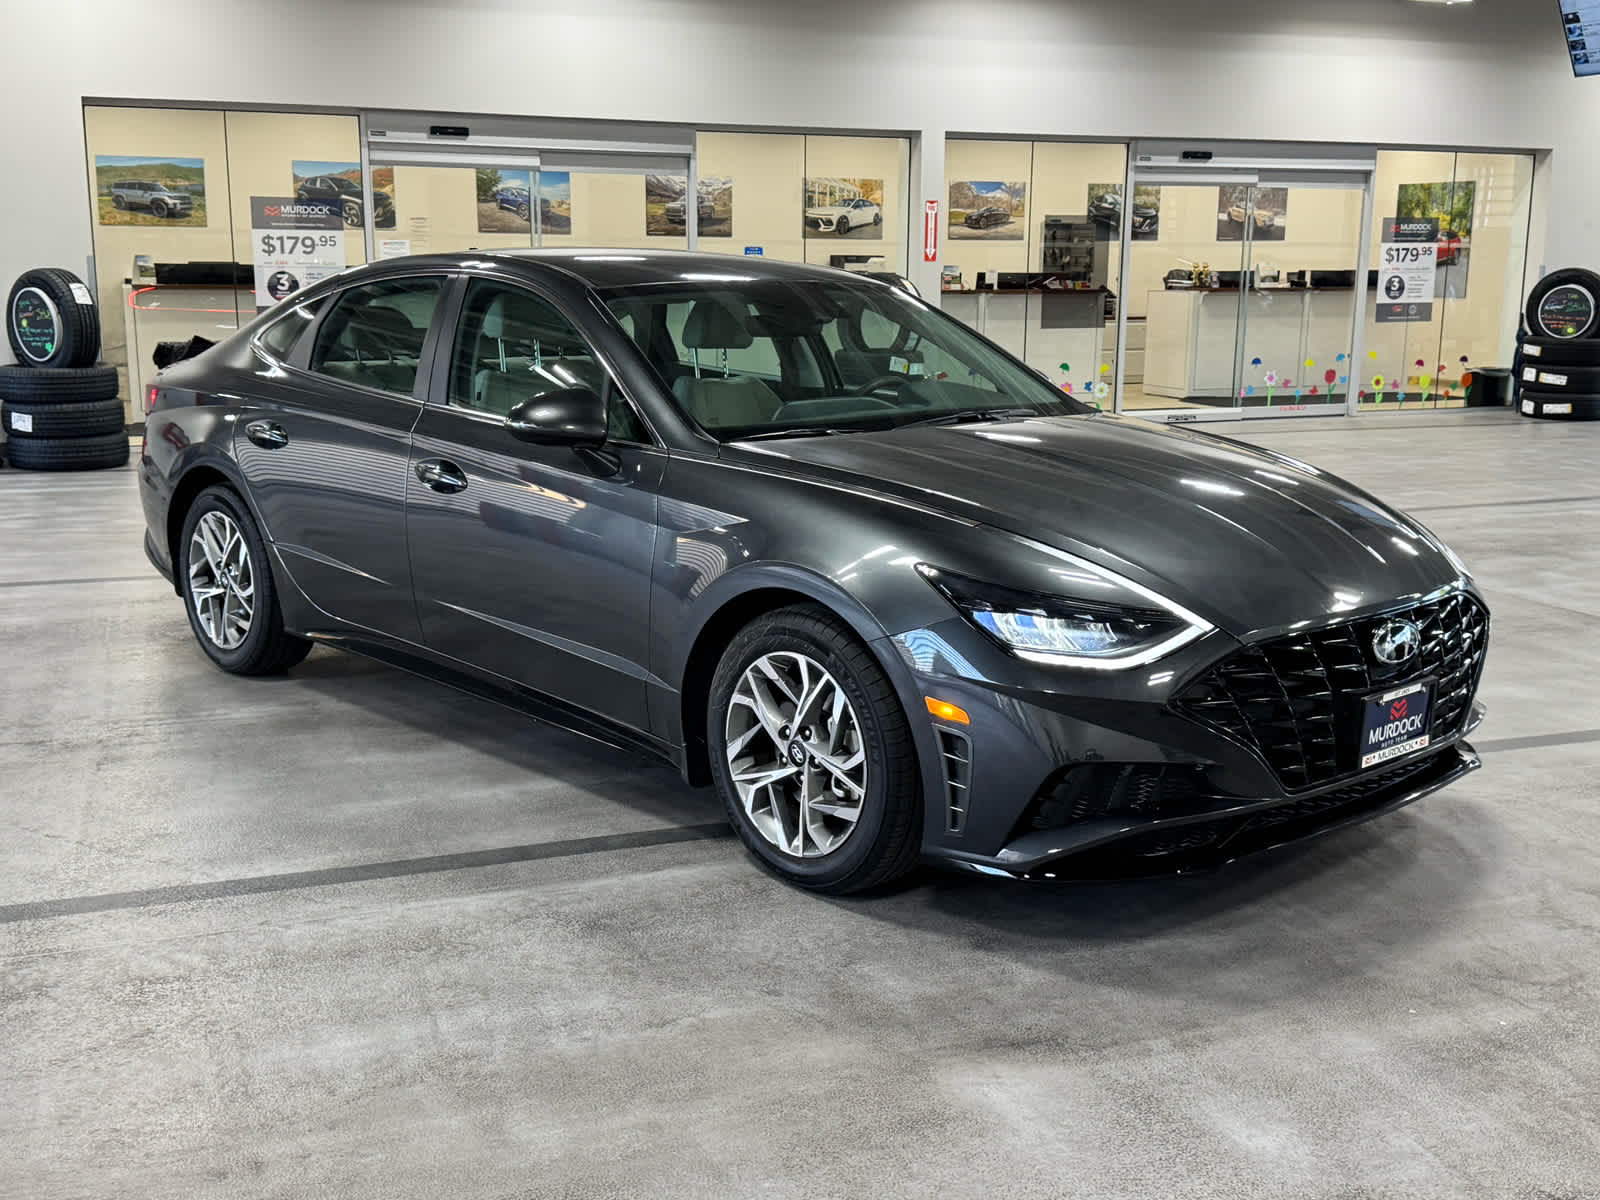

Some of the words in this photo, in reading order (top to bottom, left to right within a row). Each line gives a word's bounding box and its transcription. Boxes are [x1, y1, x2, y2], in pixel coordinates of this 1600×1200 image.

[280, 205, 330, 214] MURDOCK
[261, 234, 337, 256] $179.95
[1385, 246, 1433, 264] $179.95
[276, 273, 290, 291] 3
[1390, 277, 1400, 291] 3
[1368, 713, 1423, 745] MURDOCK
[1377, 742, 1415, 761] MURDOCK
